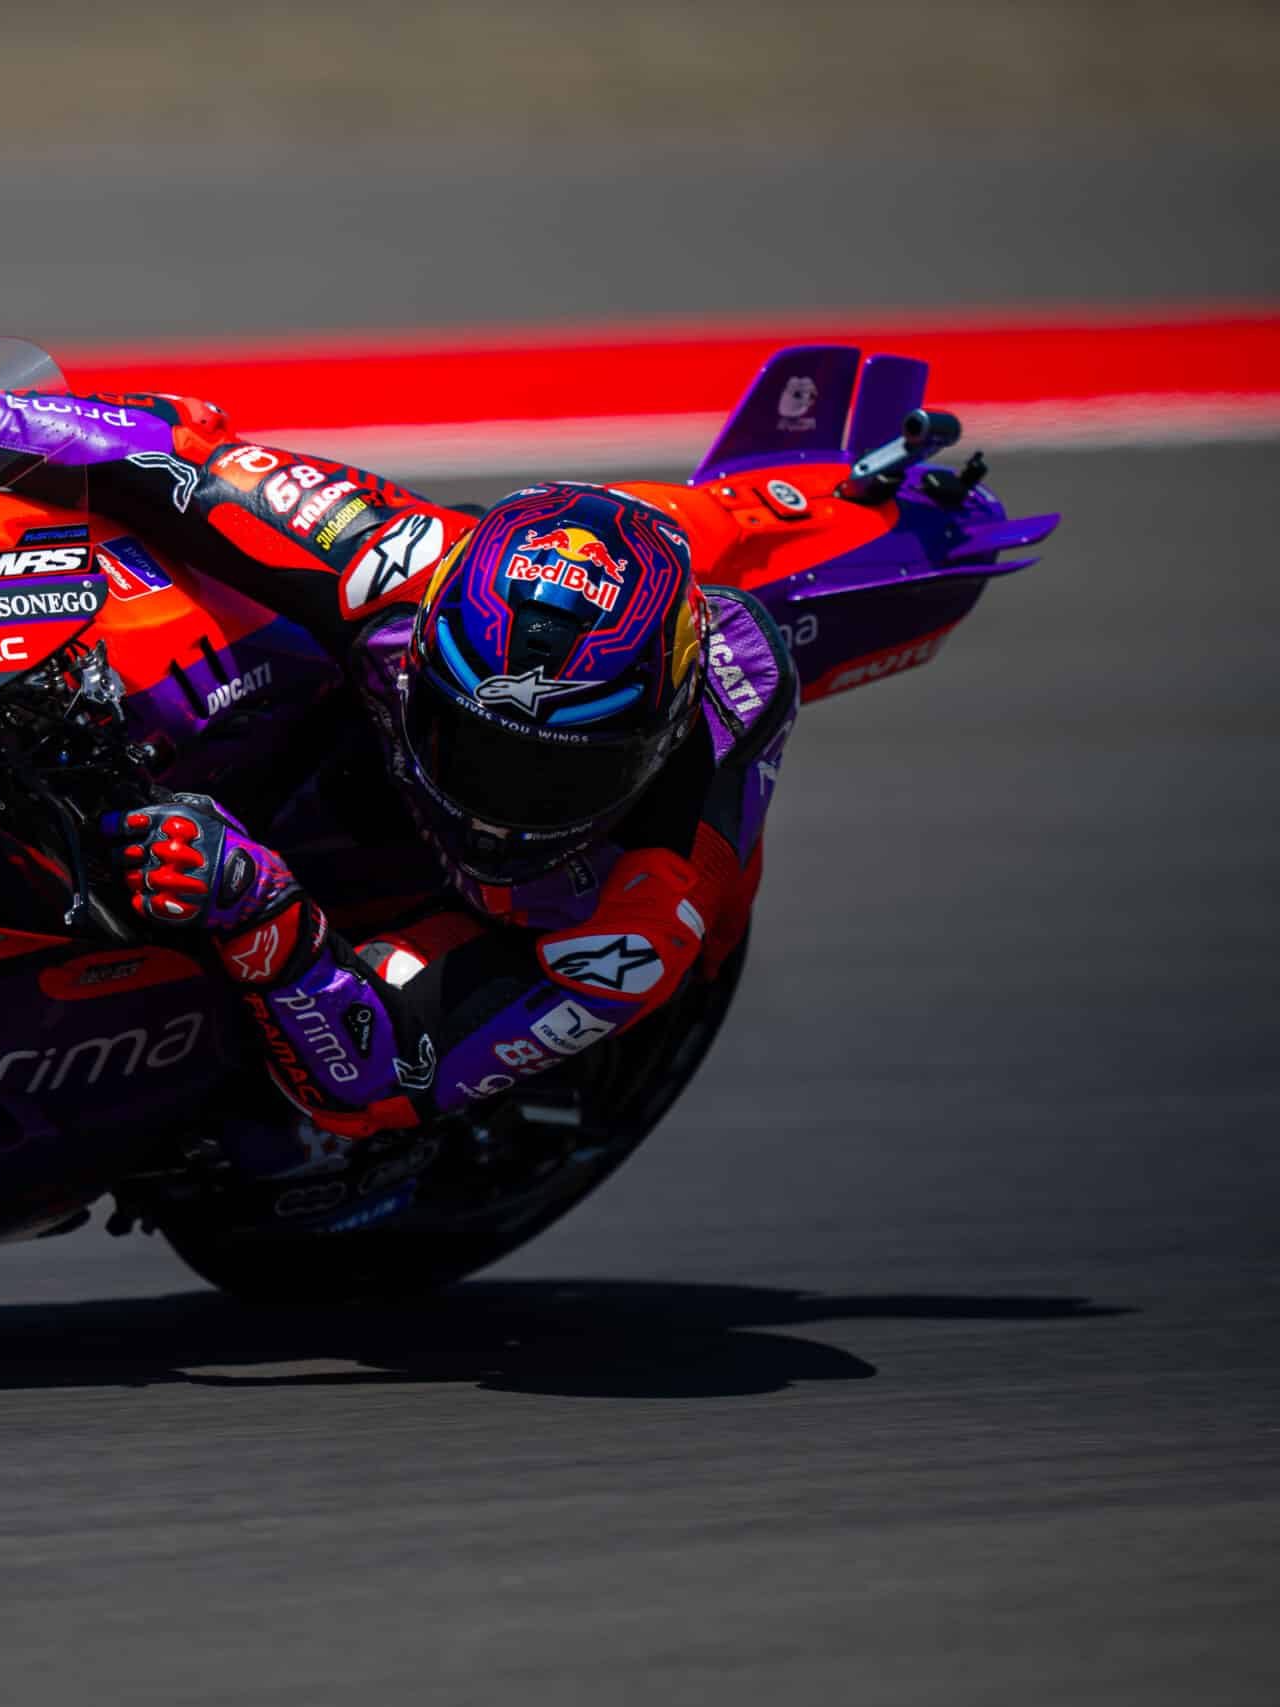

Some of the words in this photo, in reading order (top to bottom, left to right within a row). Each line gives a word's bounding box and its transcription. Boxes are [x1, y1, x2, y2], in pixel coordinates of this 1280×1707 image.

[6, 395, 137, 427] prima
[265, 464, 326, 514] 89
[506, 554, 566, 589] Red
[562, 563, 620, 612] Bull
[207, 663, 272, 716] DUCATI
[500, 717, 531, 735] YOU
[537, 729, 591, 744] WINGS
[274, 988, 359, 1083] prima
